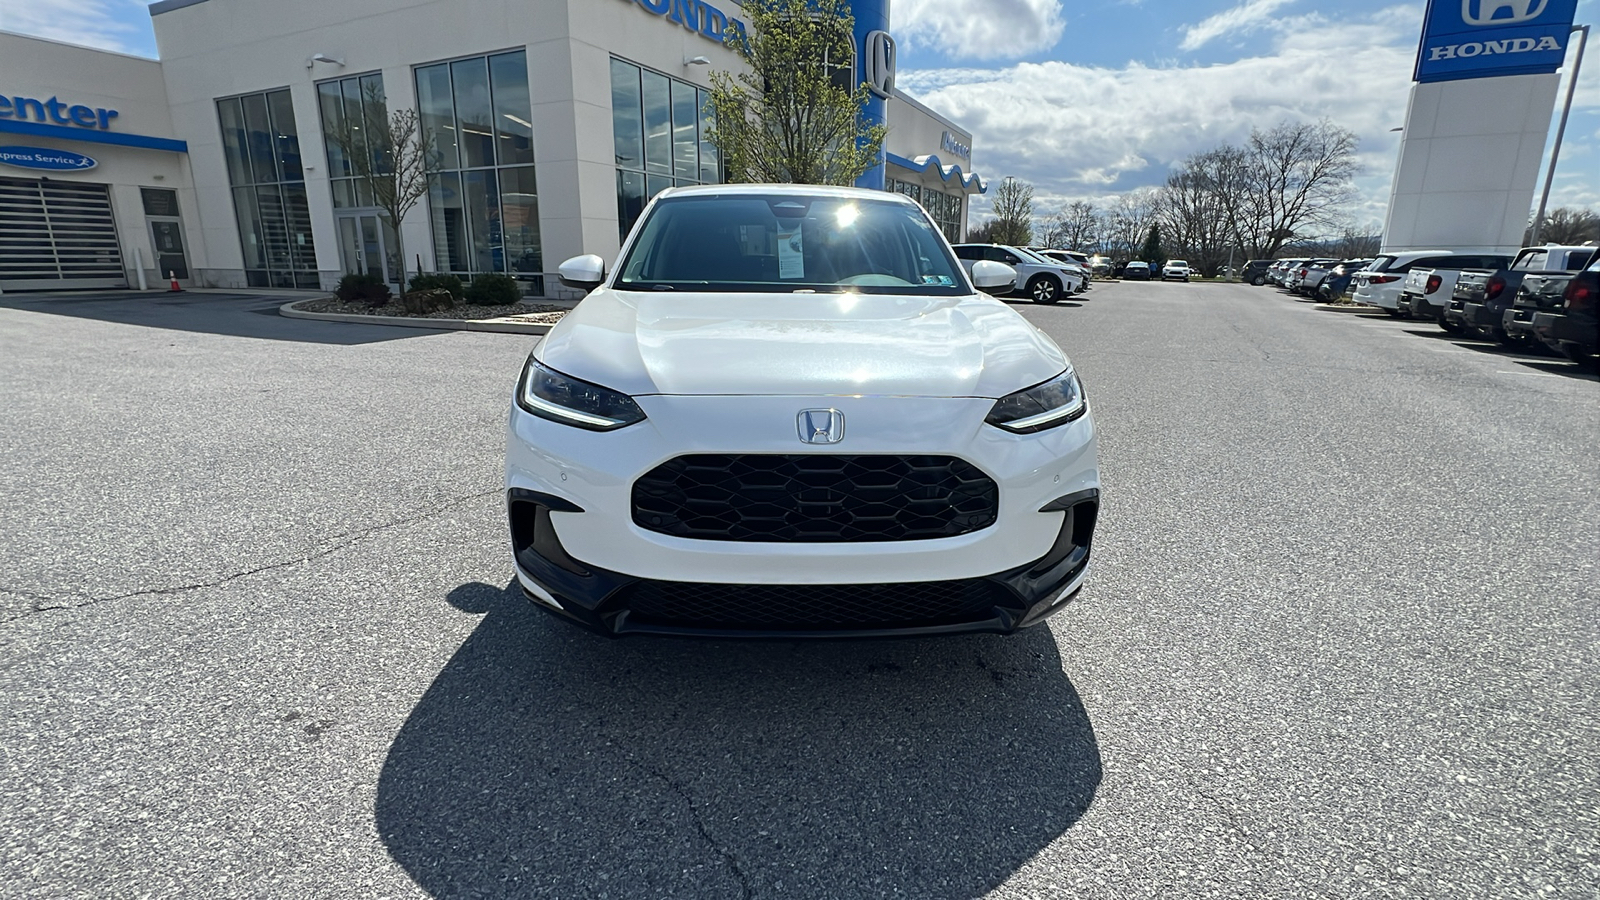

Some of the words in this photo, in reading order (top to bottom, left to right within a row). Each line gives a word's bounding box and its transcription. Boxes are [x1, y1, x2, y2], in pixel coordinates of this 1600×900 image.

[618, 0, 754, 60] NDA
[1428, 36, 1562, 61] HONDA
[35, 154, 75, 165] Service
